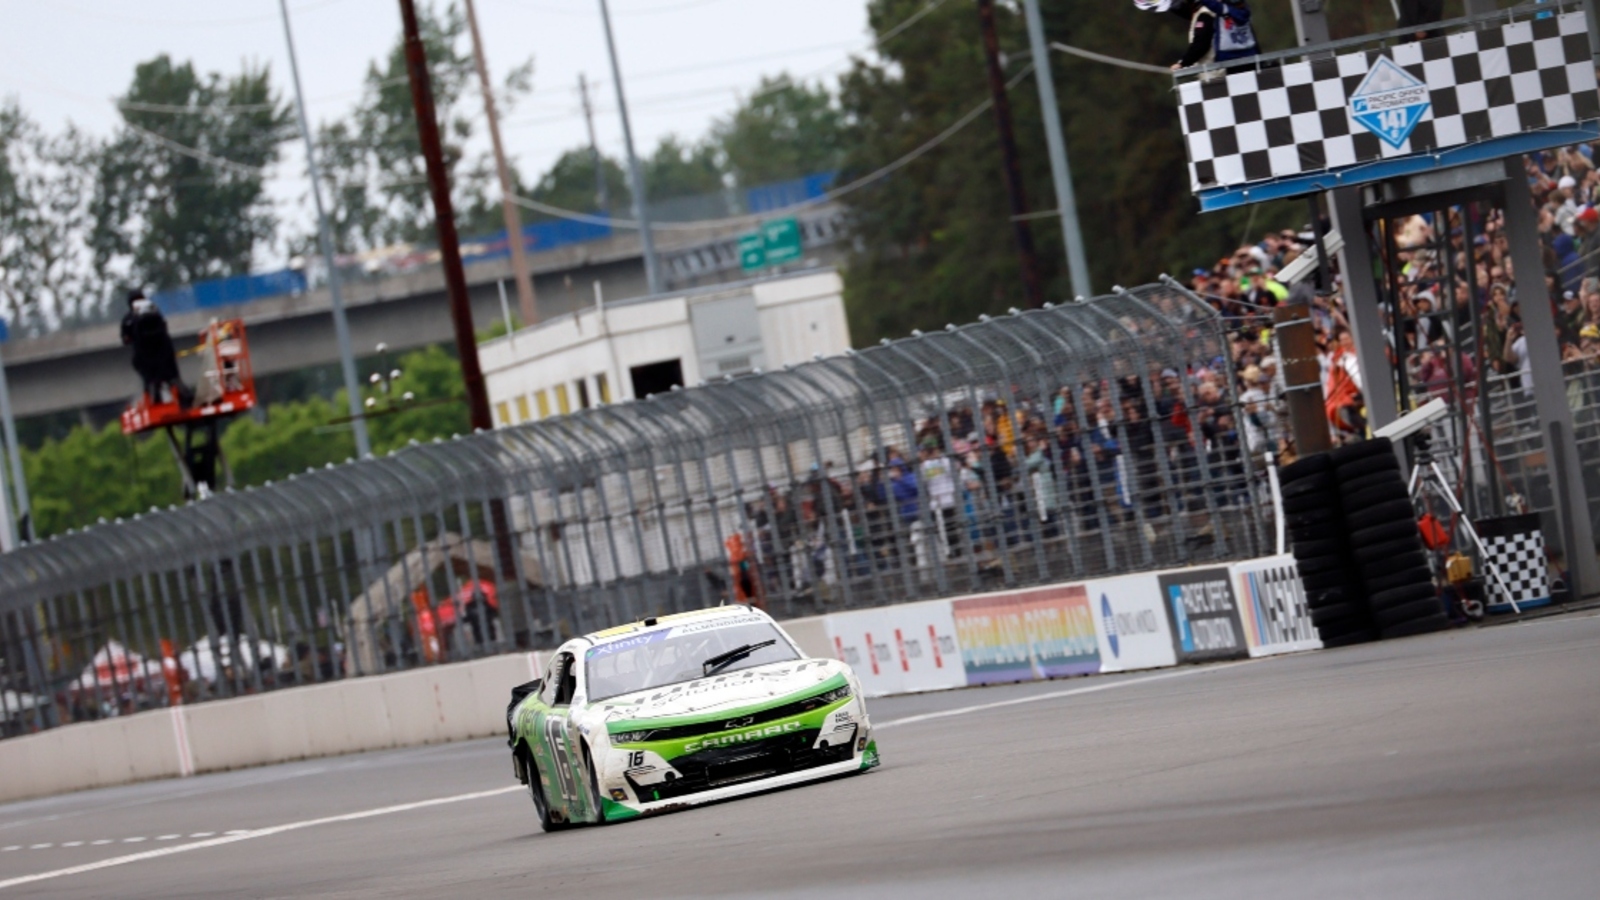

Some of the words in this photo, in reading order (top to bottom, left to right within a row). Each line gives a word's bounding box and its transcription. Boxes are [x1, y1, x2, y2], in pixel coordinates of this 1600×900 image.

[681, 616, 761, 634] ALLMENDINGER
[683, 720, 801, 753] CAMARO
[545, 715, 578, 800] 16
[627, 751, 645, 768] 16
